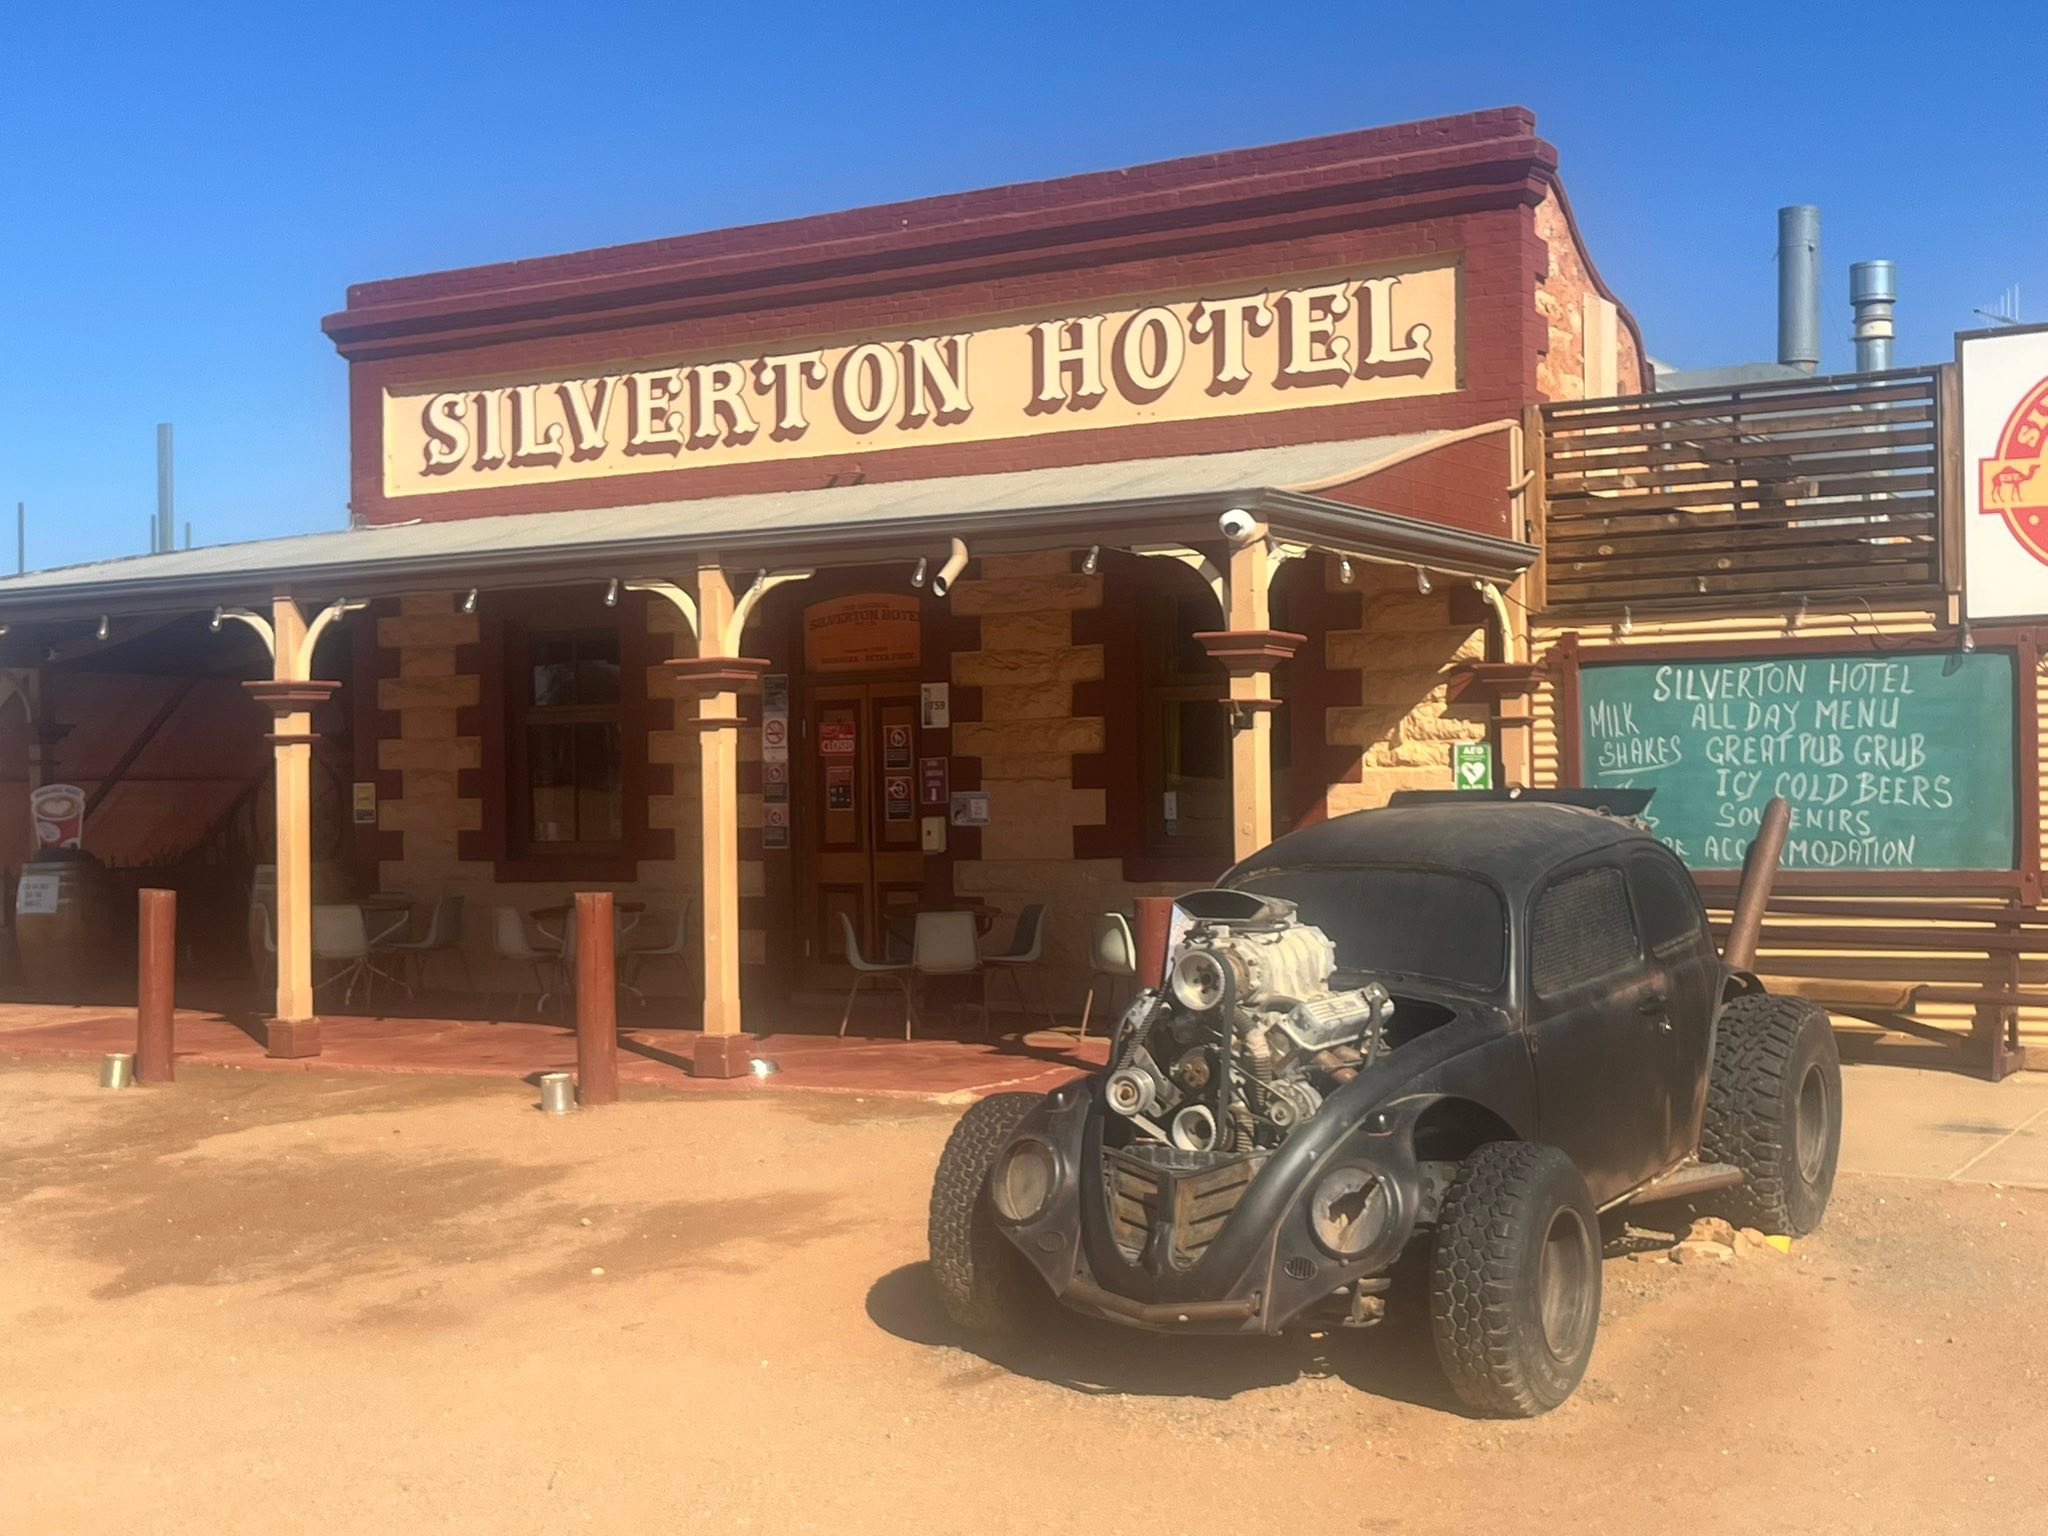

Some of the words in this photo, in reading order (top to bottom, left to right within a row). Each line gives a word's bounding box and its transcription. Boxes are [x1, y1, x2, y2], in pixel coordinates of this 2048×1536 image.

[419, 331, 974, 477] SILVERTON
[1023, 276, 1432, 417] HOTEL
[2017, 394, 2048, 448] SI
[881, 608, 920, 622] HOTE
[1653, 663, 1807, 701] SILVERTON
[1829, 662, 1915, 694] HOTEL
[1589, 699, 1640, 738] MILK
[1691, 702, 1737, 731] ALL
[1743, 700, 1800, 736] DAY
[1815, 697, 1899, 731] MENU
[1598, 735, 1682, 768] SHAKES
[1706, 734, 1794, 766] GREAT
[1798, 732, 1845, 767] PUB
[1853, 732, 1926, 773] GRUB
[1716, 768, 1763, 801] ICY
[1775, 771, 1848, 806] COLD
[1851, 771, 1953, 808] BEERS
[1714, 802, 1872, 836] SOUENIRS
